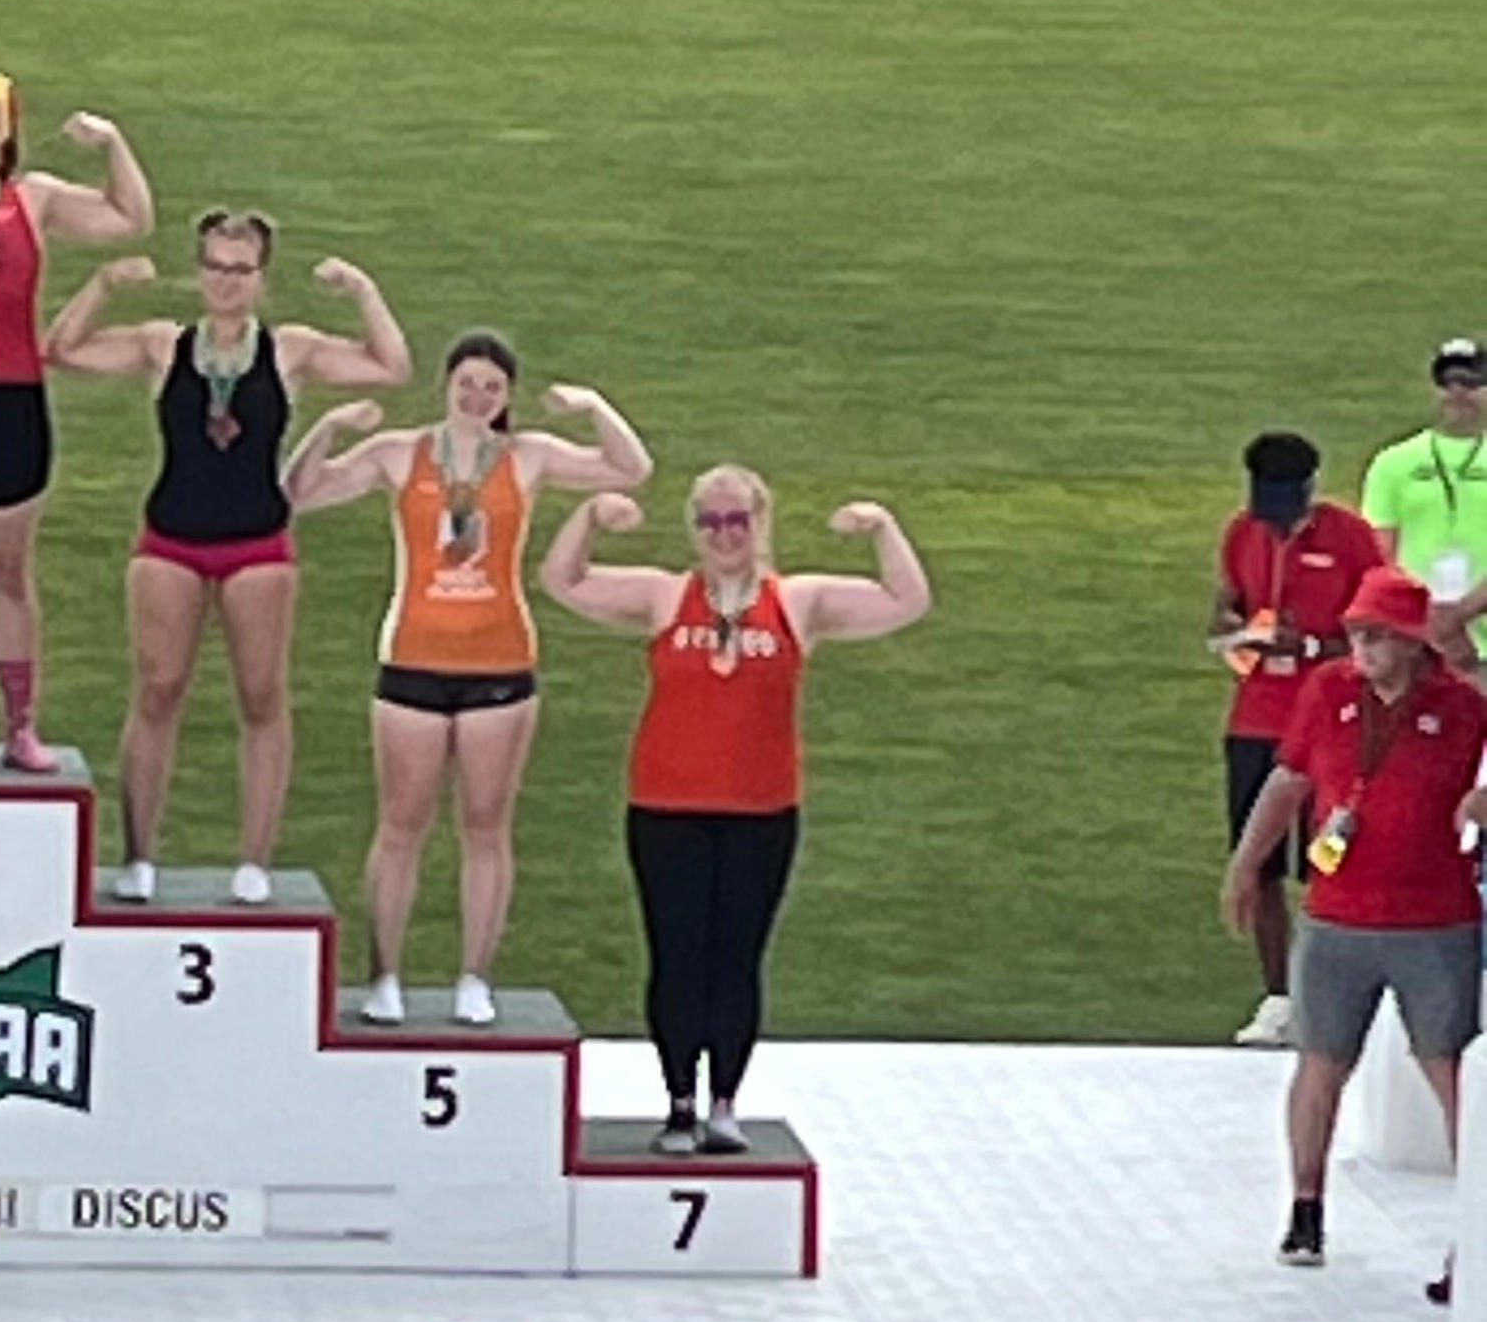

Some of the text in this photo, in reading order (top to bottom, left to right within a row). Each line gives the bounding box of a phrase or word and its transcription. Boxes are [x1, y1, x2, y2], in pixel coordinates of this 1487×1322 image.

[176, 943, 215, 1005] 3
[421, 1067, 459, 1128] 5
[72, 1188, 230, 1233] DISCUS
[670, 1190, 708, 1251] 7
